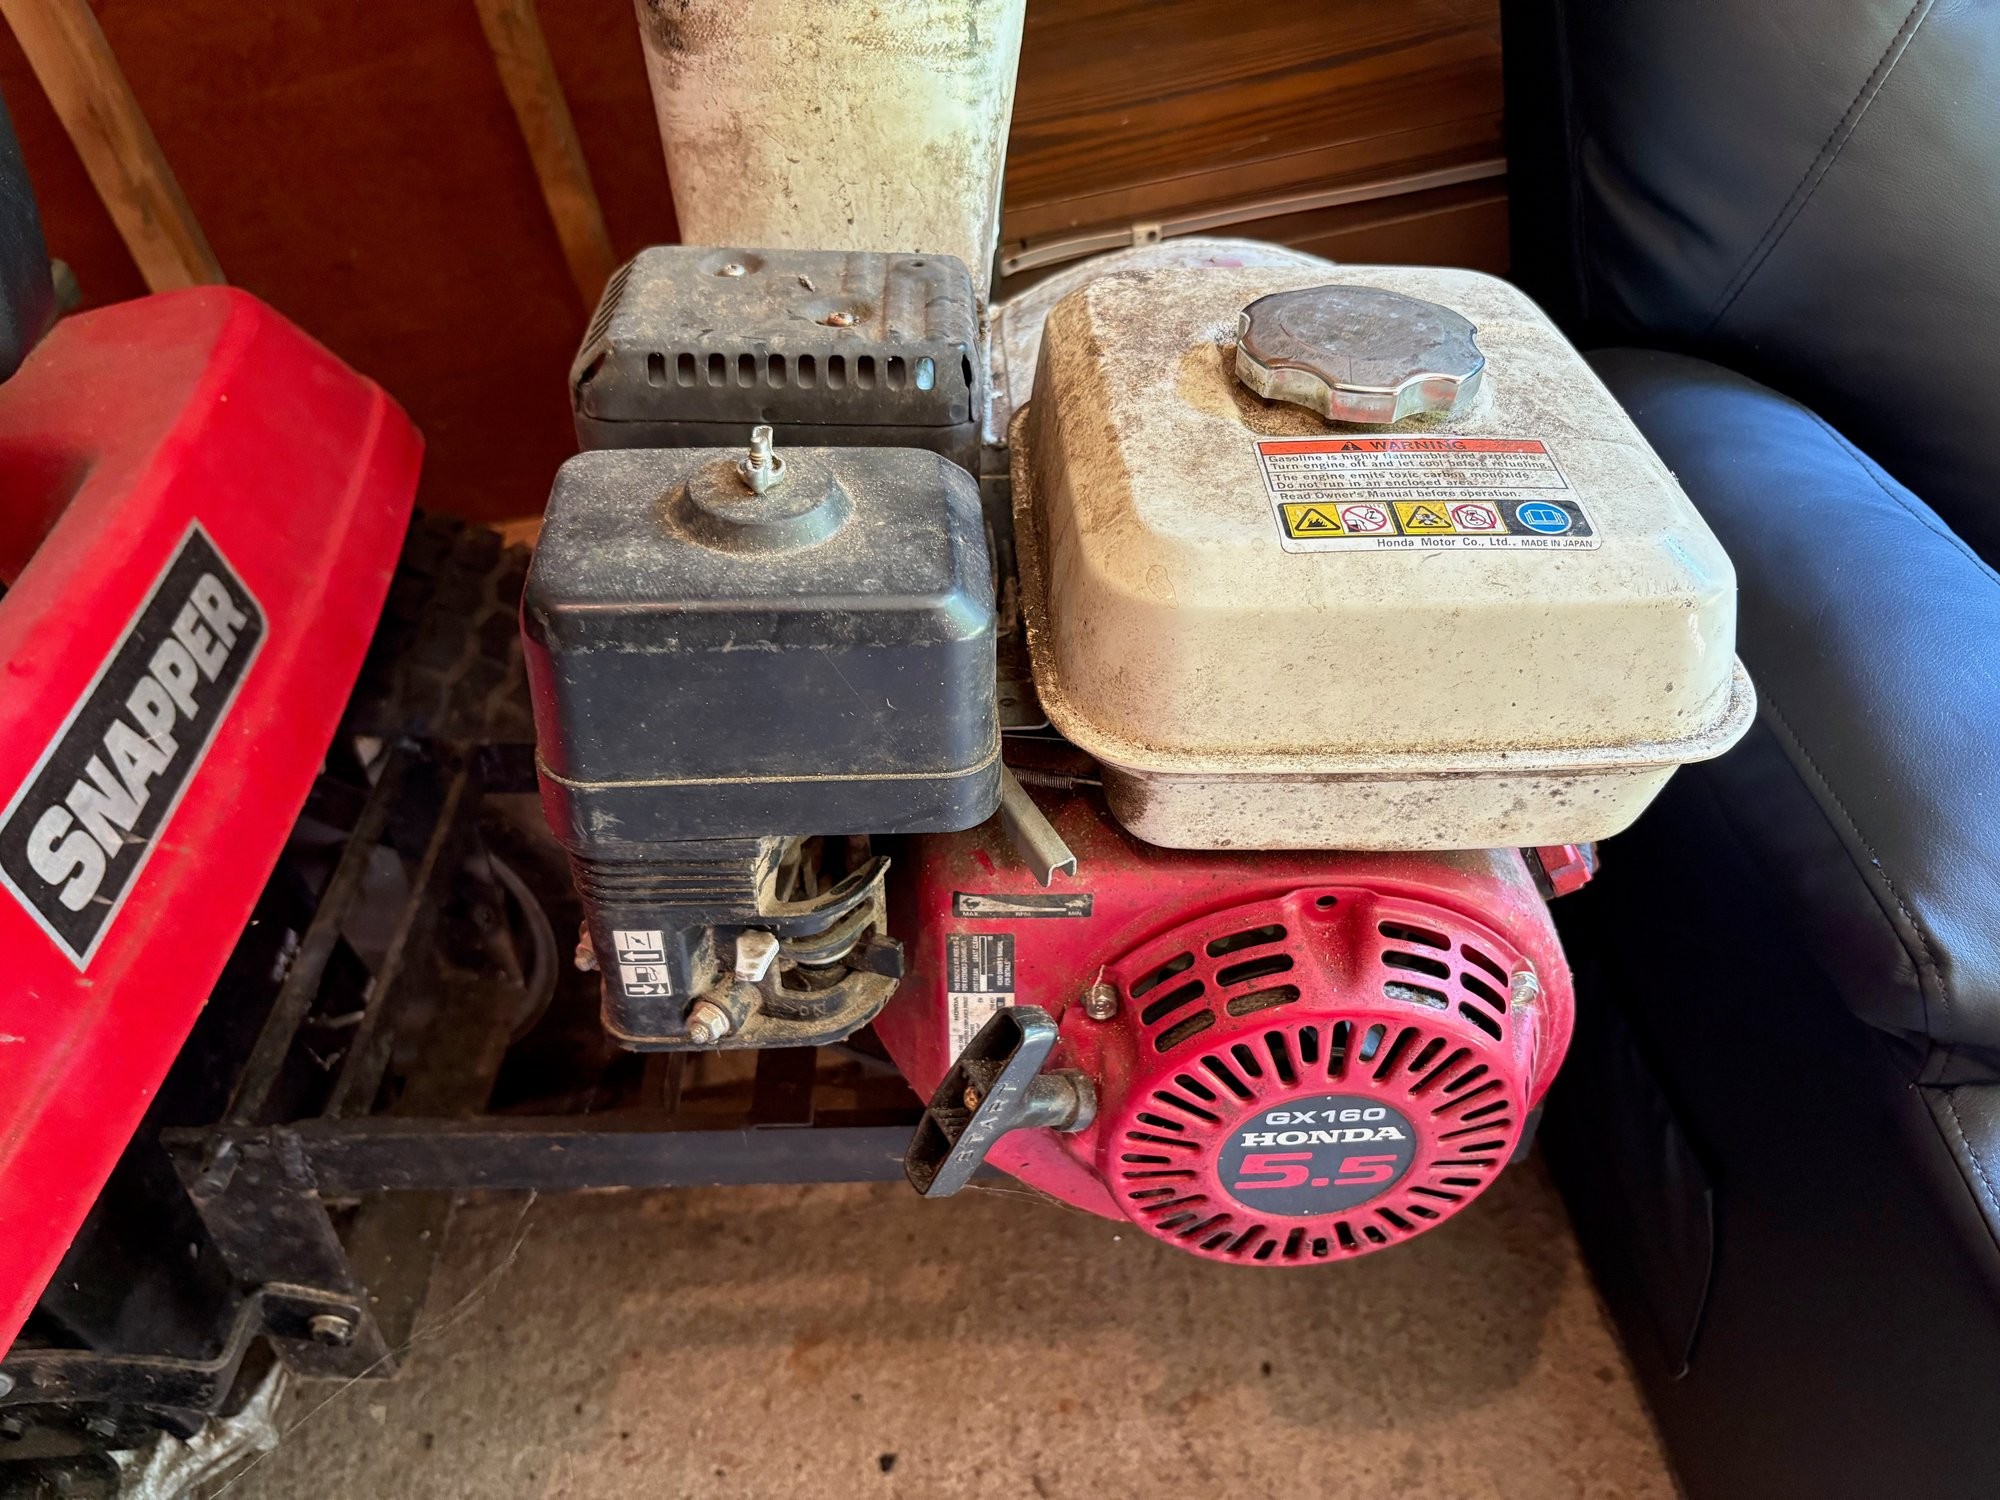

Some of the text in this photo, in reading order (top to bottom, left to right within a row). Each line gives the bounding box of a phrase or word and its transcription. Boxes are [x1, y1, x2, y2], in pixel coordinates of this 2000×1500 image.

[1370, 441, 1467, 450] WARNING
[1269, 455, 1322, 463] Gasoline
[1342, 454, 1379, 464] highly
[1382, 453, 1449, 461] flammable
[1372, 460, 1396, 468] and
[1491, 460, 1551, 469] refueling.
[1274, 474, 1298, 482] The
[1303, 472, 1345, 482] engine
[1470, 471, 1534, 479] monoxide.
[1277, 482, 1294, 490] Do
[1299, 481, 1322, 489] not
[1388, 479, 1442, 487] enclosed
[1280, 489, 1521, 501] Read Owner's Manual before operation.
[1377, 538, 1414, 547] Honda
[1421, 538, 1455, 547] Motor
[1462, 538, 1485, 547] Co.,
[1563, 540, 1593, 548] JAPAN
[26, 572, 248, 912] SNAPPER
[955, 1082, 1017, 1163] START
[1240, 1126, 1406, 1147] HONDA
[1234, 1152, 1398, 1190] 5.5
